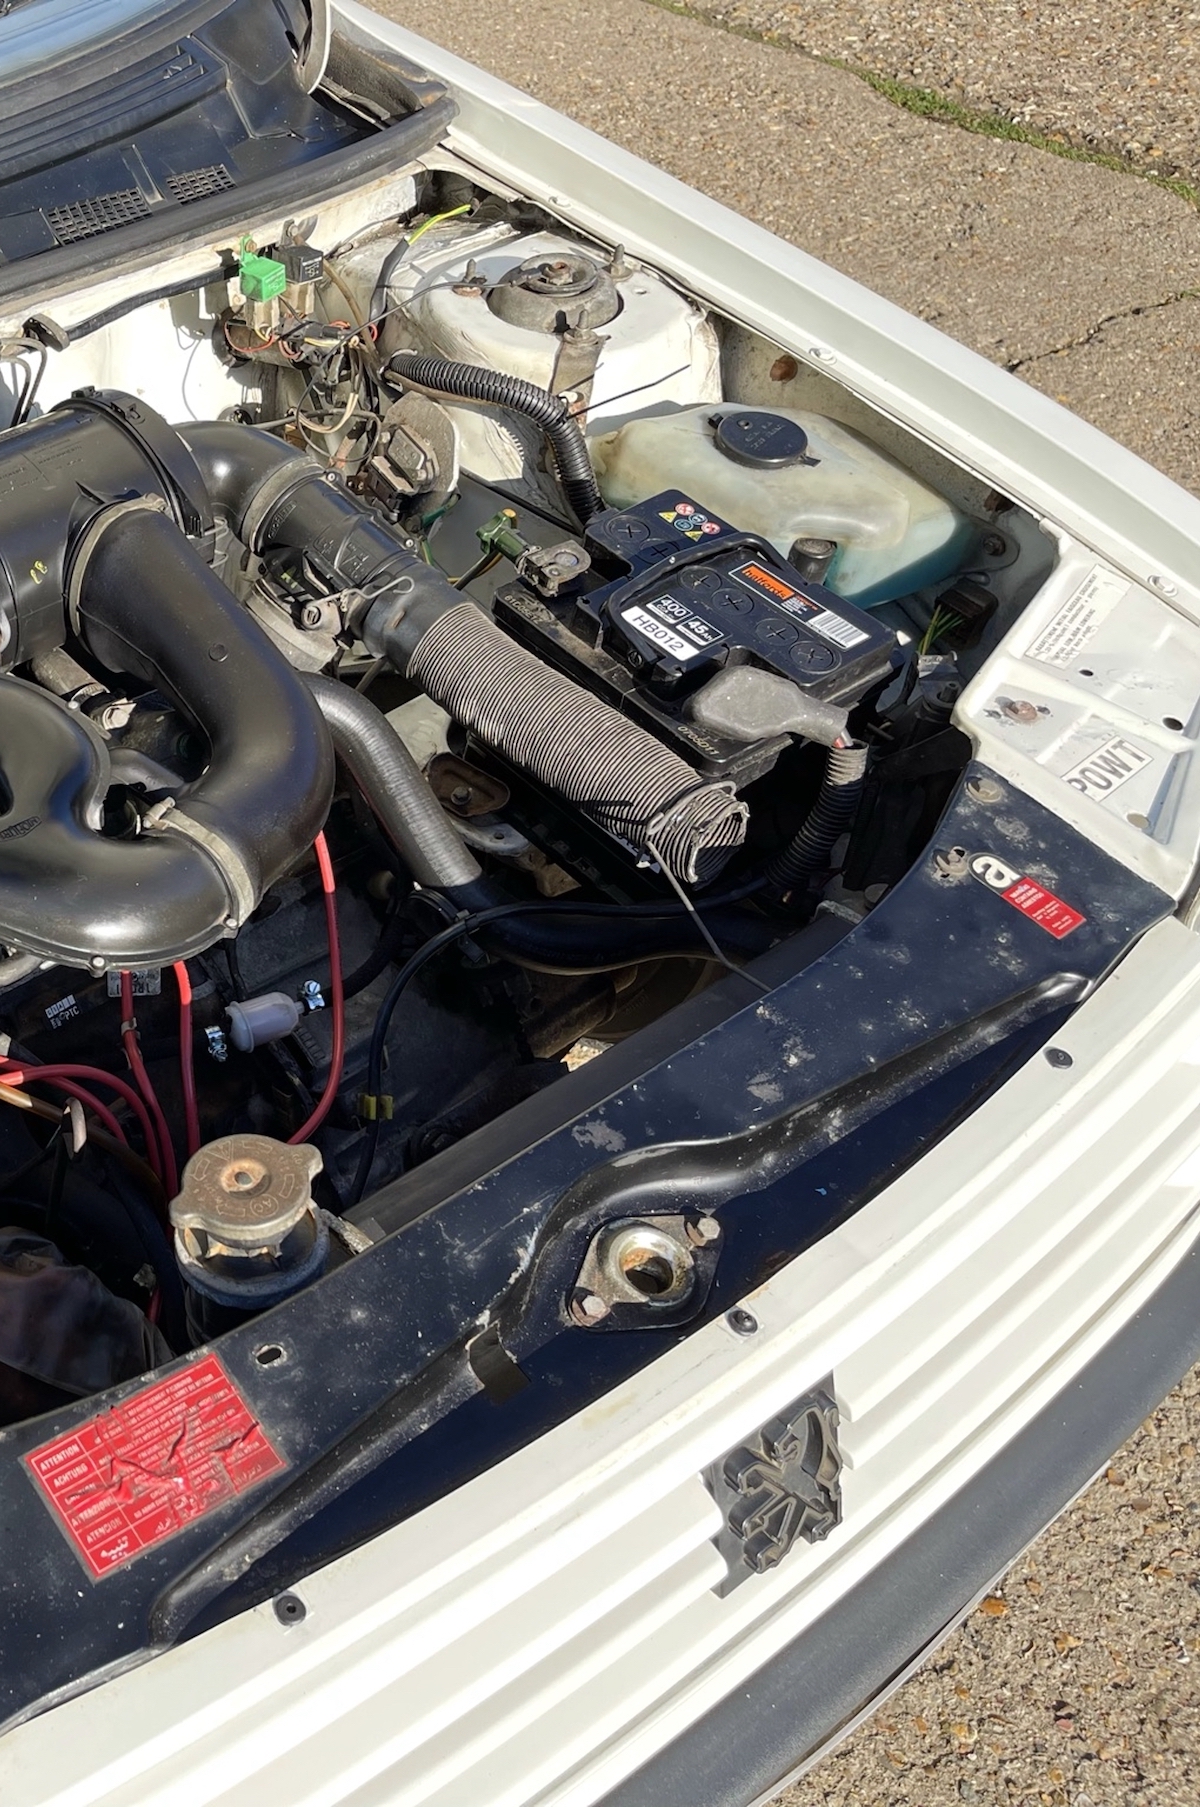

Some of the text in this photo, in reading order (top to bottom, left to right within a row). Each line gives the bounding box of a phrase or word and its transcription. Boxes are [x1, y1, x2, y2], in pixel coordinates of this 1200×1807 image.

[742, 567, 788, 600] halfords
[659, 598, 687, 617] 400
[631, 614, 684, 652] HB012
[972, 856, 1021, 889] a
[39, 1444, 79, 1471] ATTENTION
[52, 1463, 87, 1487] ACHTUNG
[70, 1495, 114, 1526] ATTENZIONE
[85, 1517, 122, 1543] ATENCION
